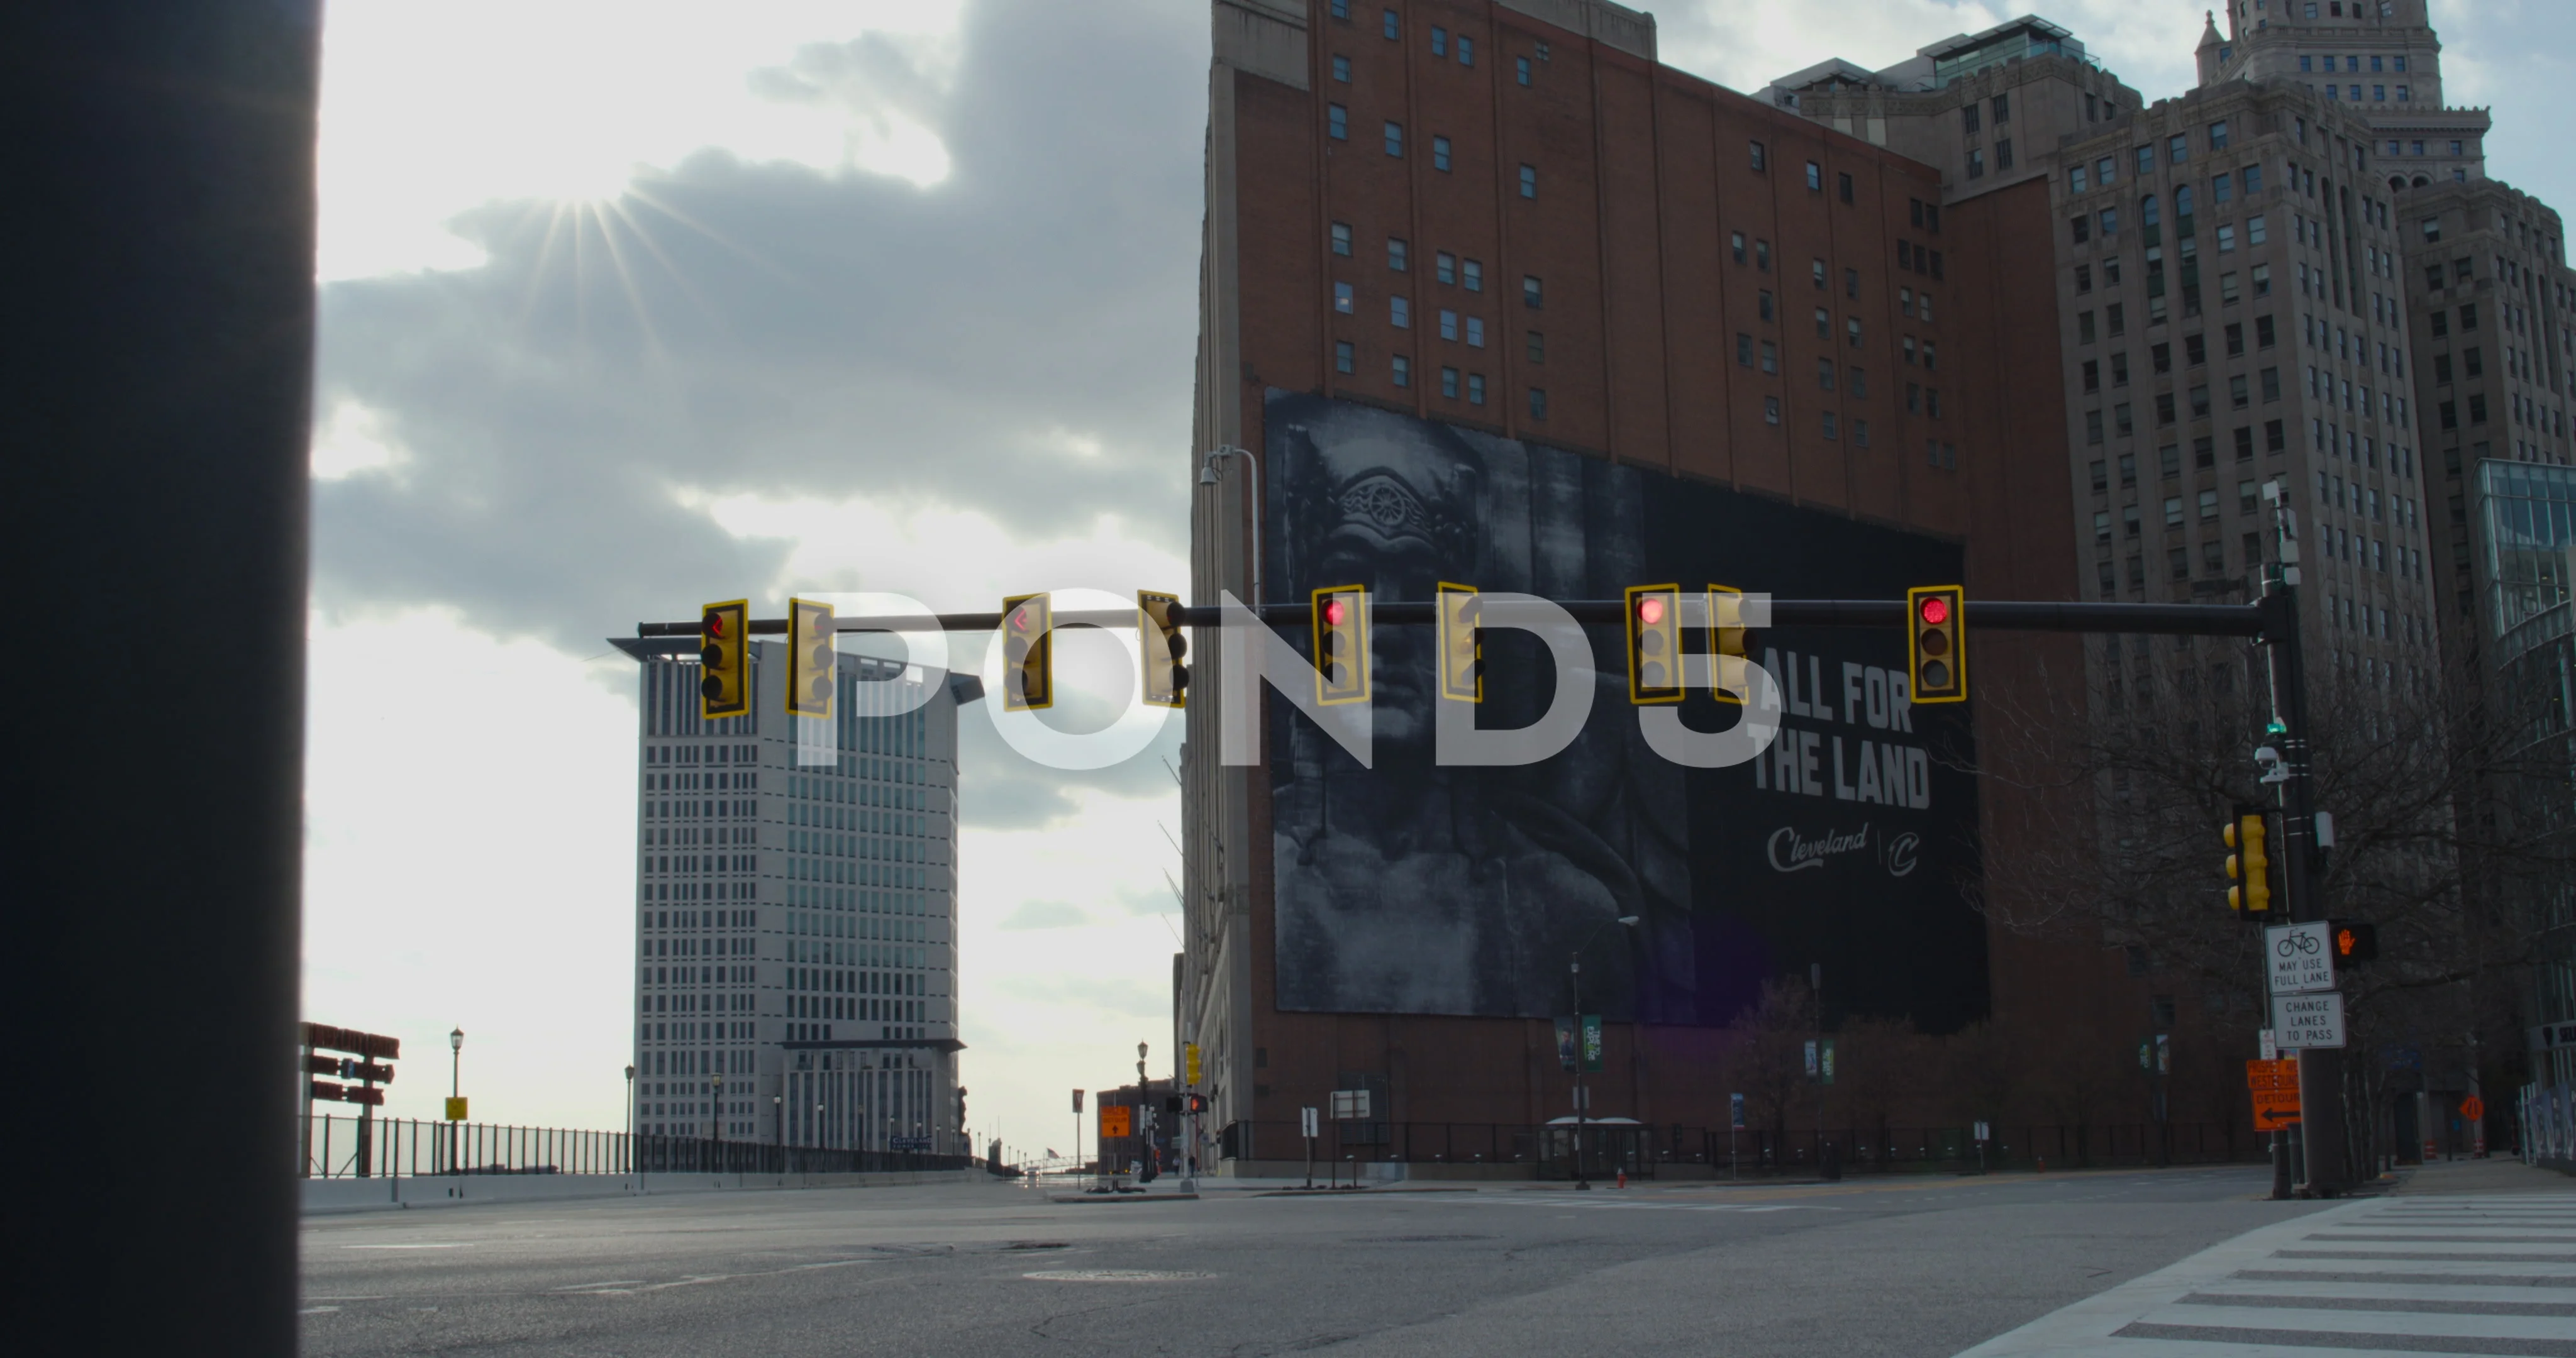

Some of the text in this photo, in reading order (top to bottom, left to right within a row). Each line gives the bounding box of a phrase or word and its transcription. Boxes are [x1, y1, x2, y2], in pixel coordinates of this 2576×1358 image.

[1760, 647, 1913, 734] ALL FOR
[1747, 723, 1930, 810] THE LAND
[1767, 822, 1869, 873] Cleveland
[2279, 958, 2323, 973] MAY USE
[2274, 971, 2329, 986] FULL LANE
[2285, 1000, 2329, 1013] CHANGE
[2290, 1015, 2326, 1027] LANES
[2287, 1029, 2333, 1041] TO PASS
[2257, 1093, 2300, 1105] DETOUR
